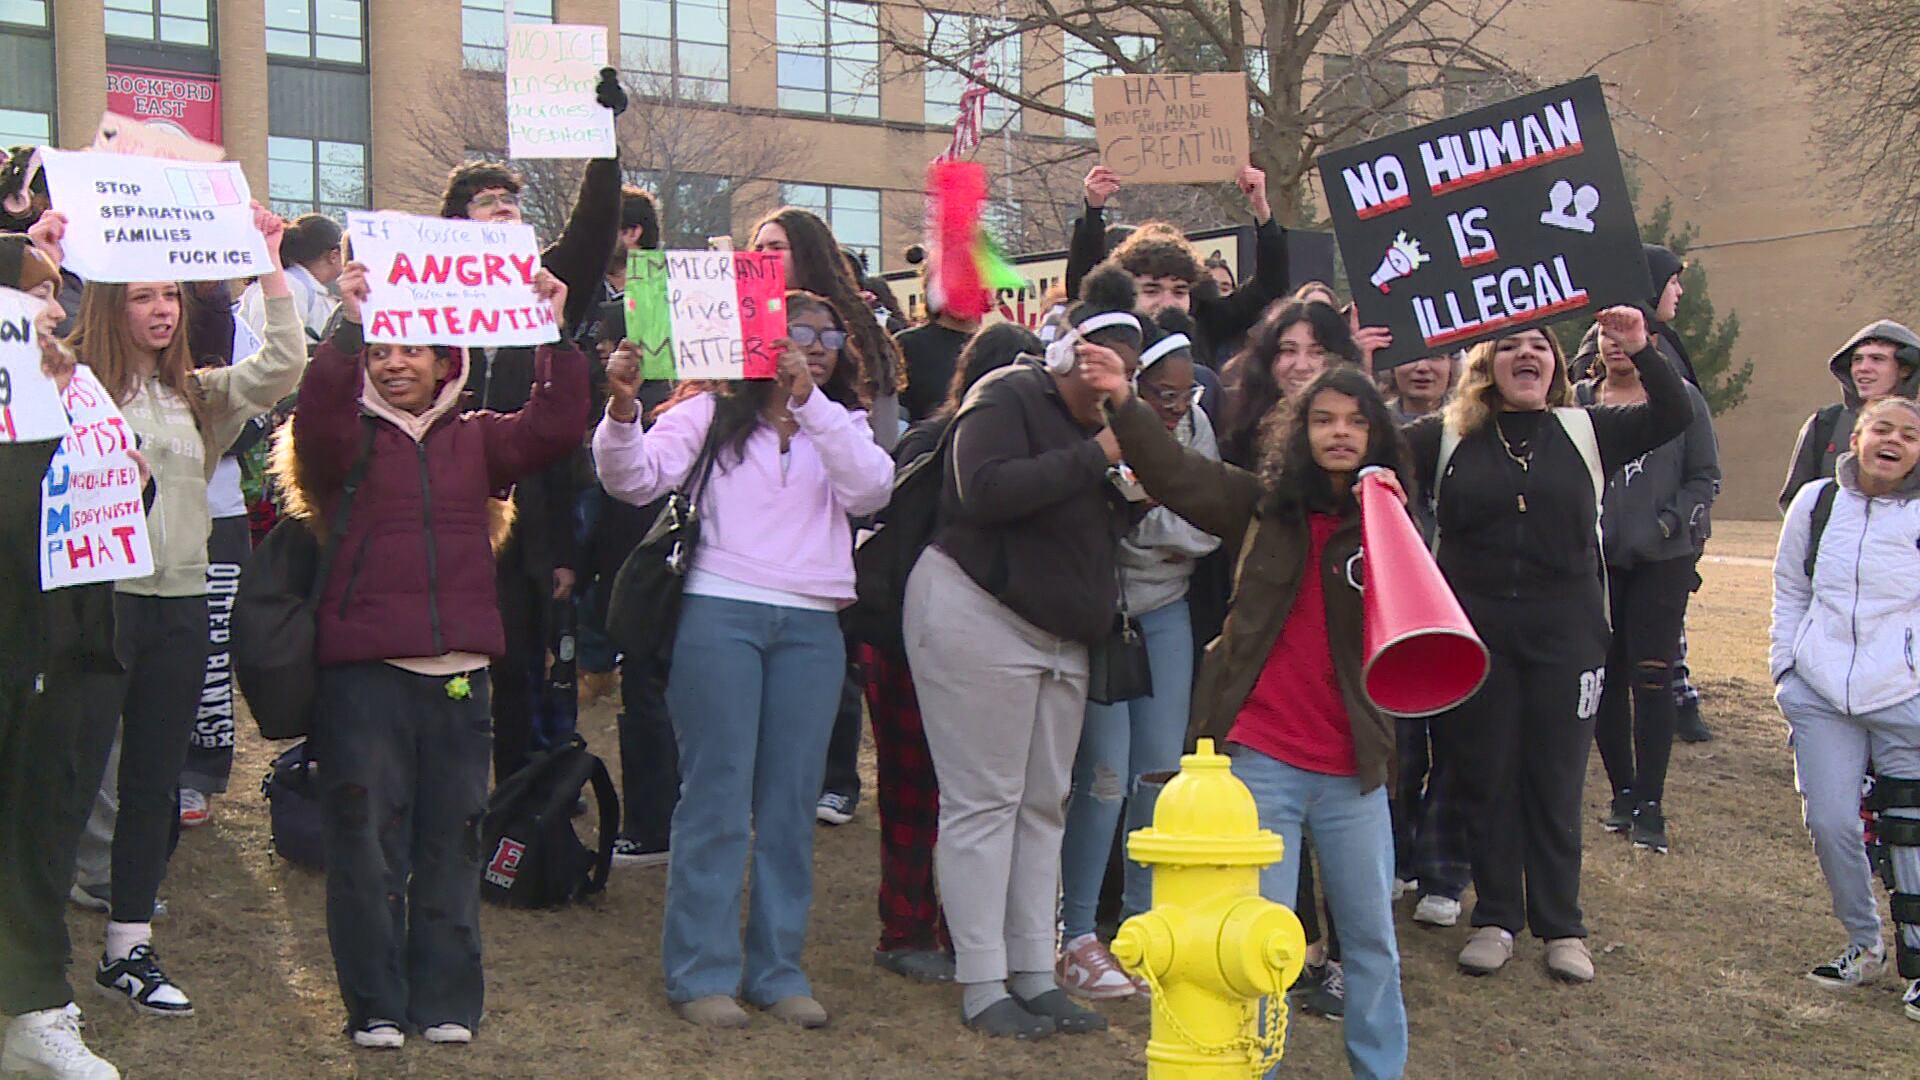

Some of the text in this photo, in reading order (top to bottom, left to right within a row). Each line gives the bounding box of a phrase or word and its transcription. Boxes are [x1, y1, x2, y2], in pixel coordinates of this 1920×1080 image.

[512, 30, 604, 66] NO ICE
[106, 75, 213, 102] ROCKFORD
[1123, 75, 1206, 104] HATE
[134, 96, 186, 118] EAST
[1103, 103, 1212, 127] NEVER MADE
[1342, 98, 1583, 210] NO HUMAN
[96, 181, 141, 196] STOP
[100, 205, 215, 221] SEPARATING
[105, 228, 192, 243] FAMILIES
[1447, 206, 1496, 259] IS
[169, 250, 252, 265] FUCK ICE
[387, 252, 535, 286] ANGRY
[626, 254, 780, 281] IMMIGRANT
[1412, 255, 1588, 338] ILLEGAL
[639, 336, 769, 369] MATTER
[48, 526, 136, 577] PHAT
[206, 563, 241, 644] OUTER
[196, 652, 234, 735] BANKS
